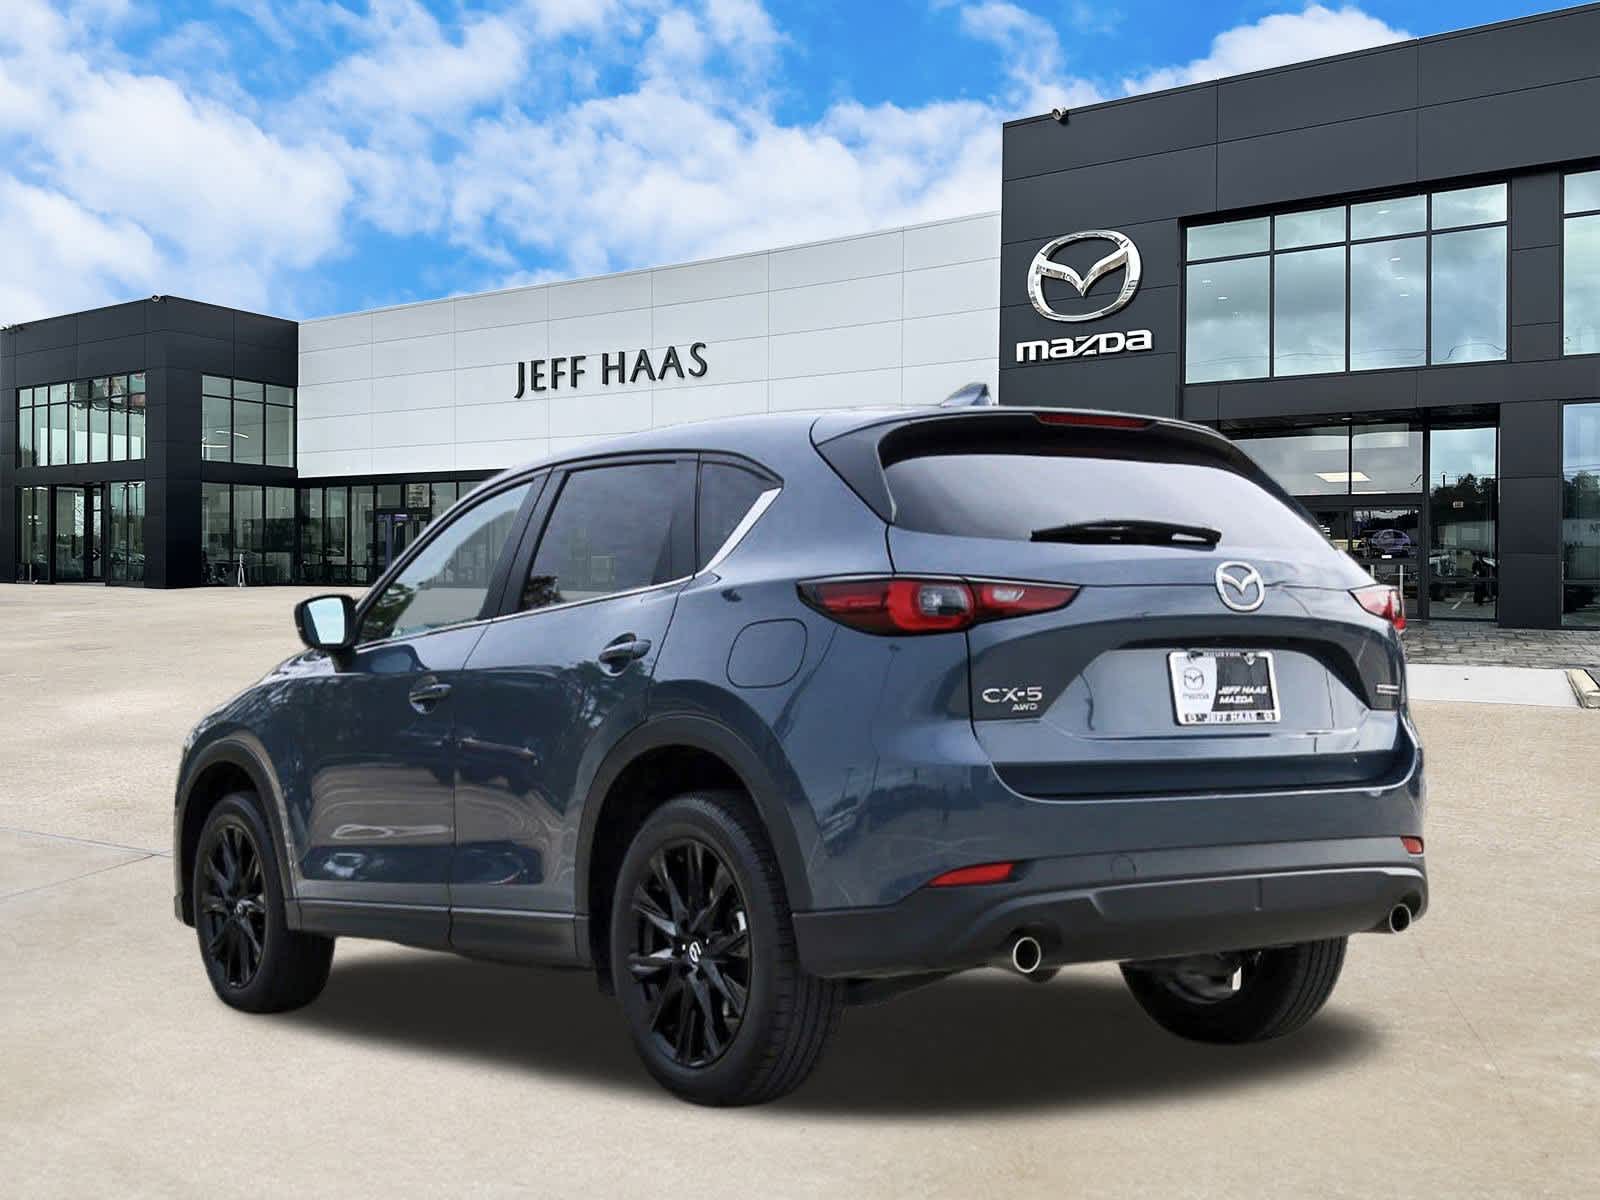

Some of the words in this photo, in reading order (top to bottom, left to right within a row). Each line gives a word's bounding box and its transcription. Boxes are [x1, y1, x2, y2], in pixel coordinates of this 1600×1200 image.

[1016, 329, 1153, 363] mazda
[513, 355, 587, 399] JEFF
[601, 342, 708, 386] HAAS
[982, 686, 1043, 703] CX-5
[1218, 686, 1241, 695] JEFF
[1241, 685, 1268, 695] HAAS
[1219, 695, 1254, 704] MAZDA
[1011, 703, 1038, 712] AWD
